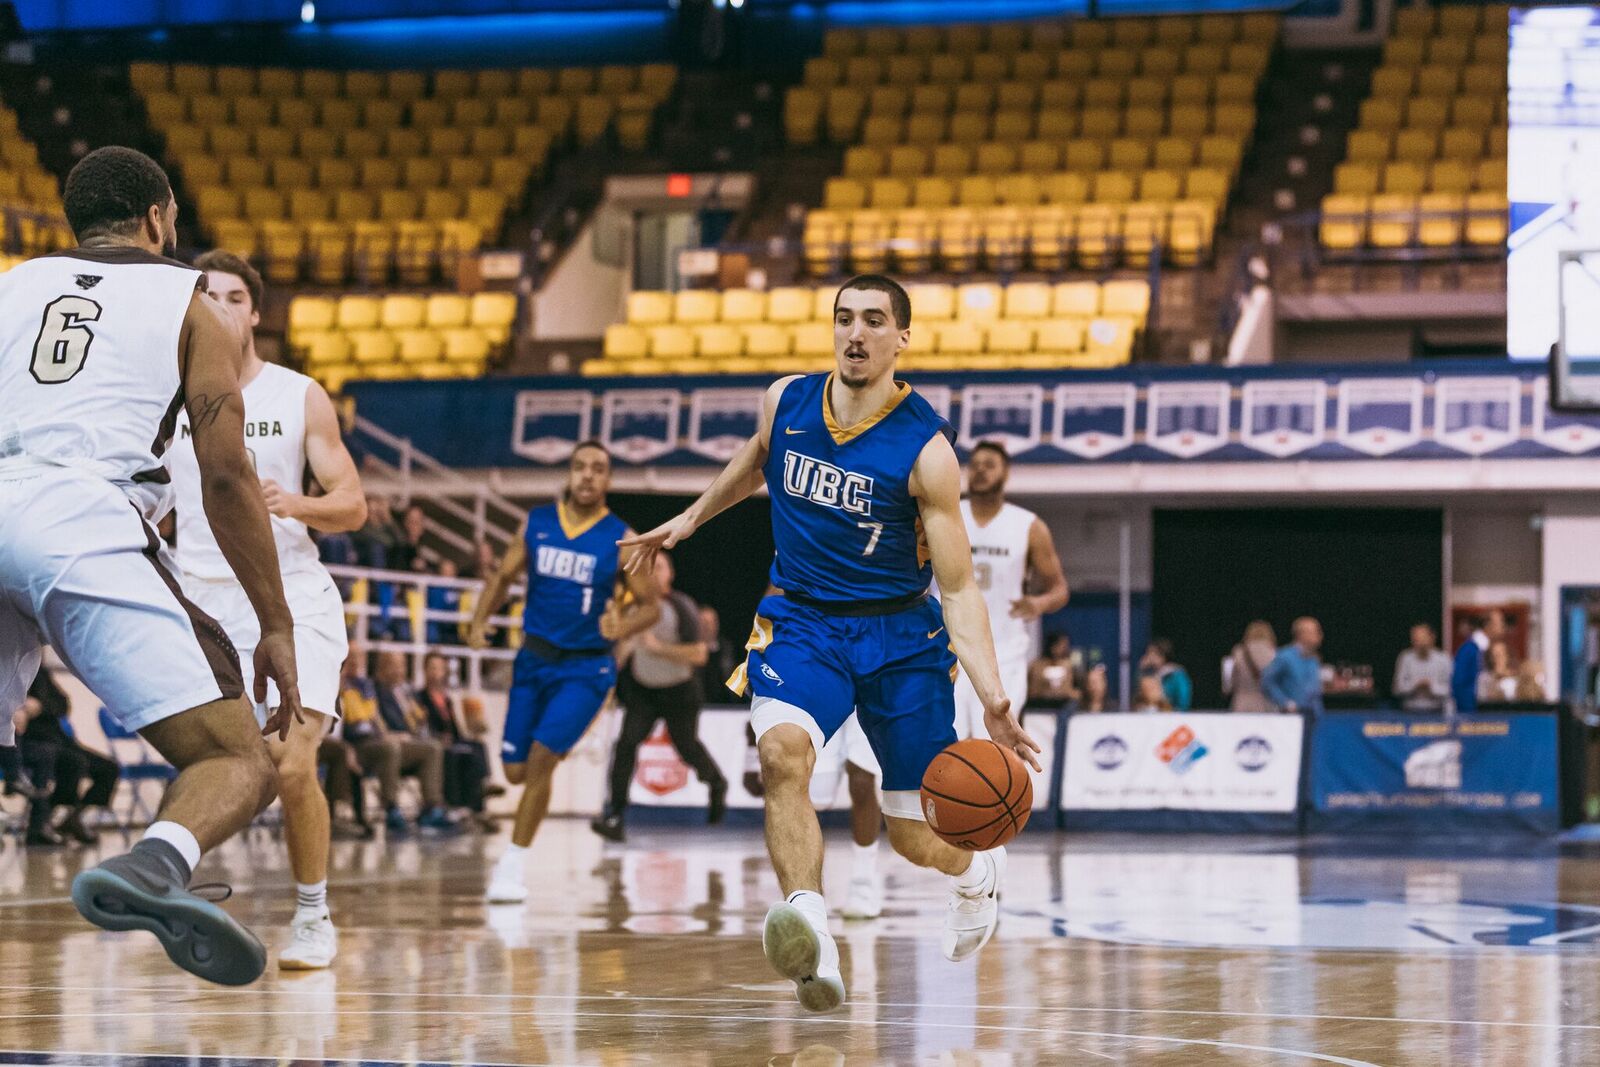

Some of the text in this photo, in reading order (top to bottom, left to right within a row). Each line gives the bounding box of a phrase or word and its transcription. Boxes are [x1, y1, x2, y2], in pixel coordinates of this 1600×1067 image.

[29, 294, 103, 384] 6
[181, 420, 282, 440] MOBA
[784, 449, 874, 516] UBC
[857, 521, 883, 556] 7
[536, 544, 598, 585] UBC
[581, 586, 594, 615] 1
